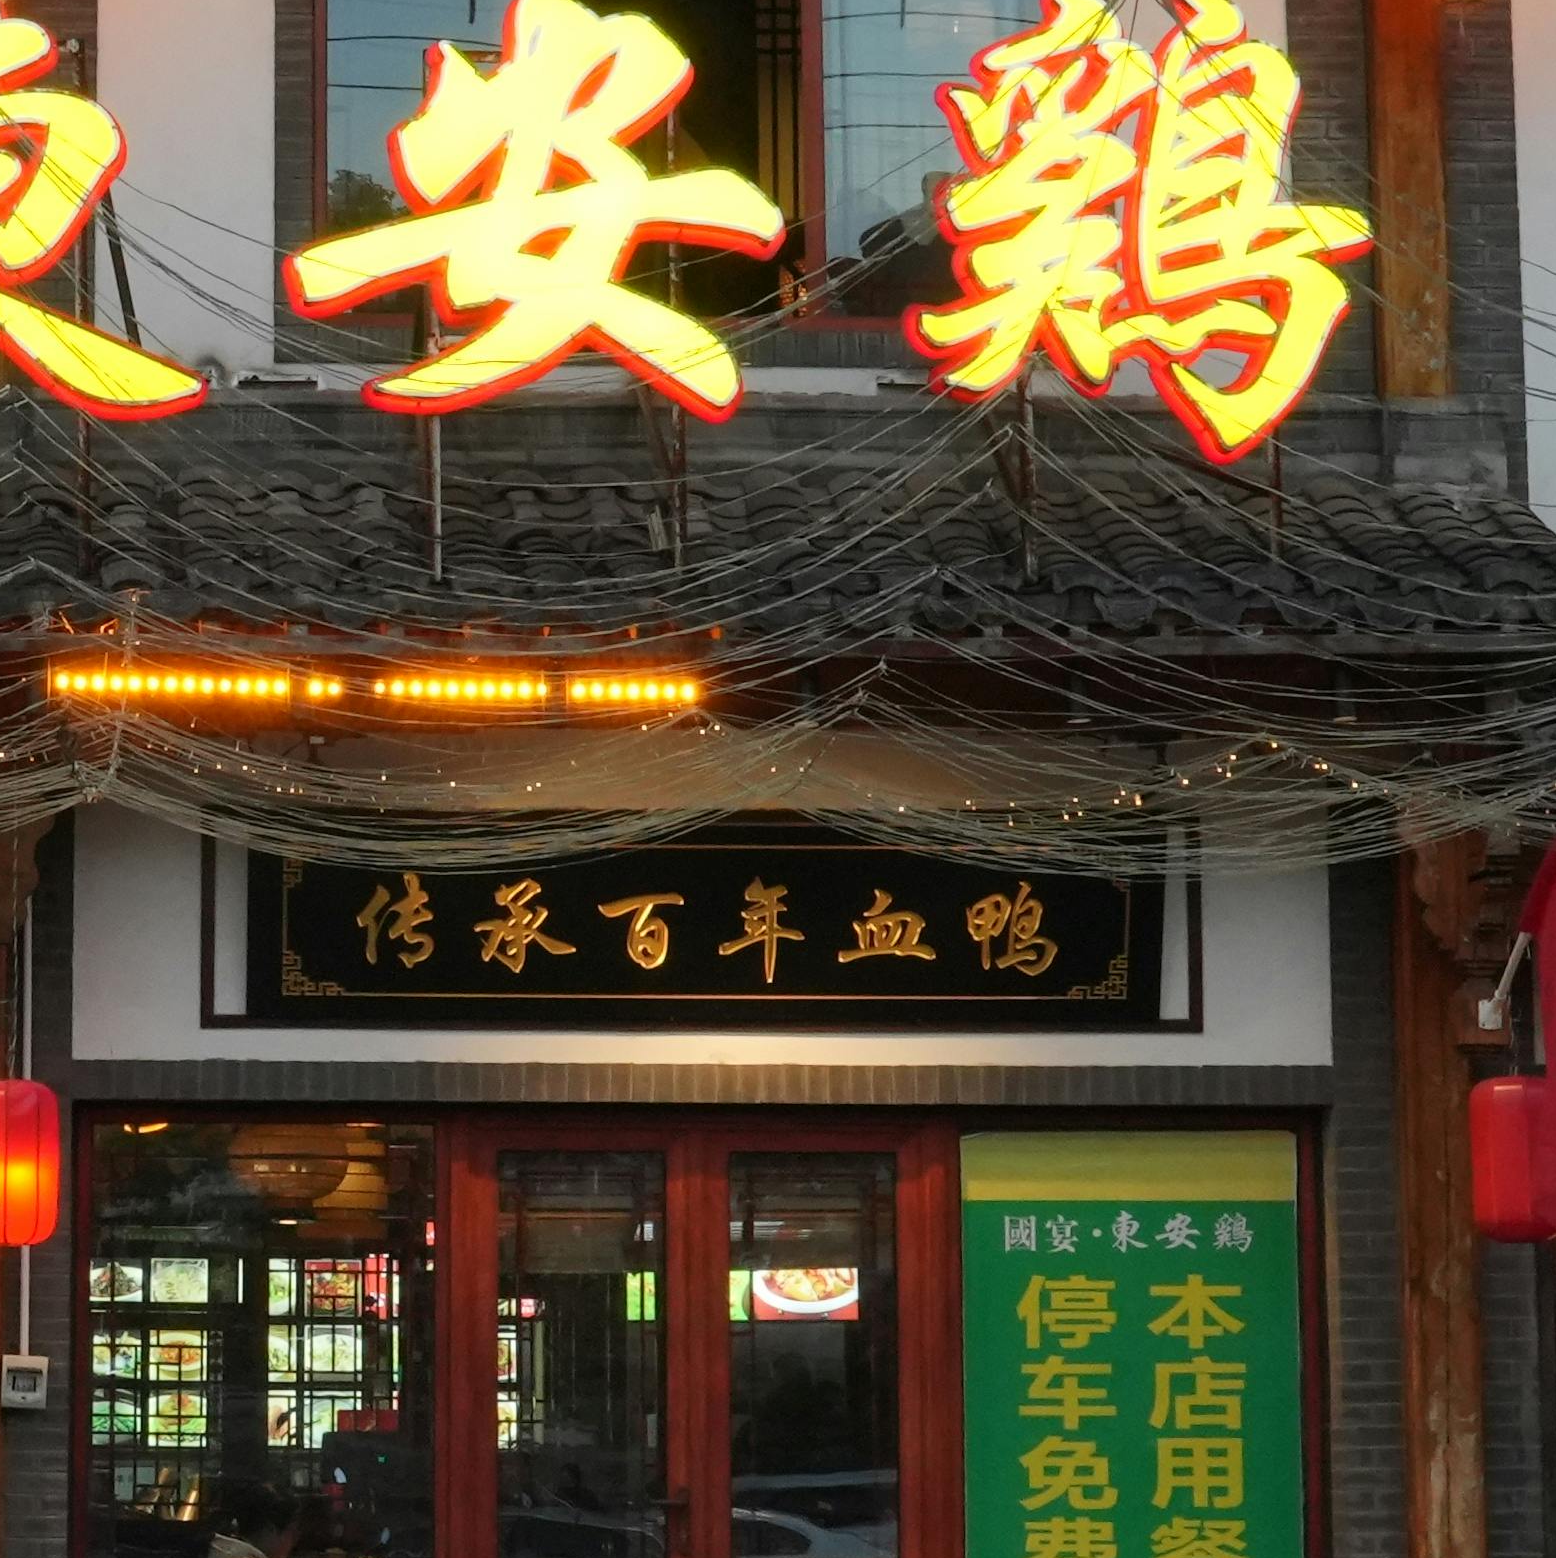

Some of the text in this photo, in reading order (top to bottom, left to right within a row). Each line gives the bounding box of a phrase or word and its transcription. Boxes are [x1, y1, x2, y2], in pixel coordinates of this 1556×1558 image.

[355, 871, 1058, 985] 传承百年血鸭
